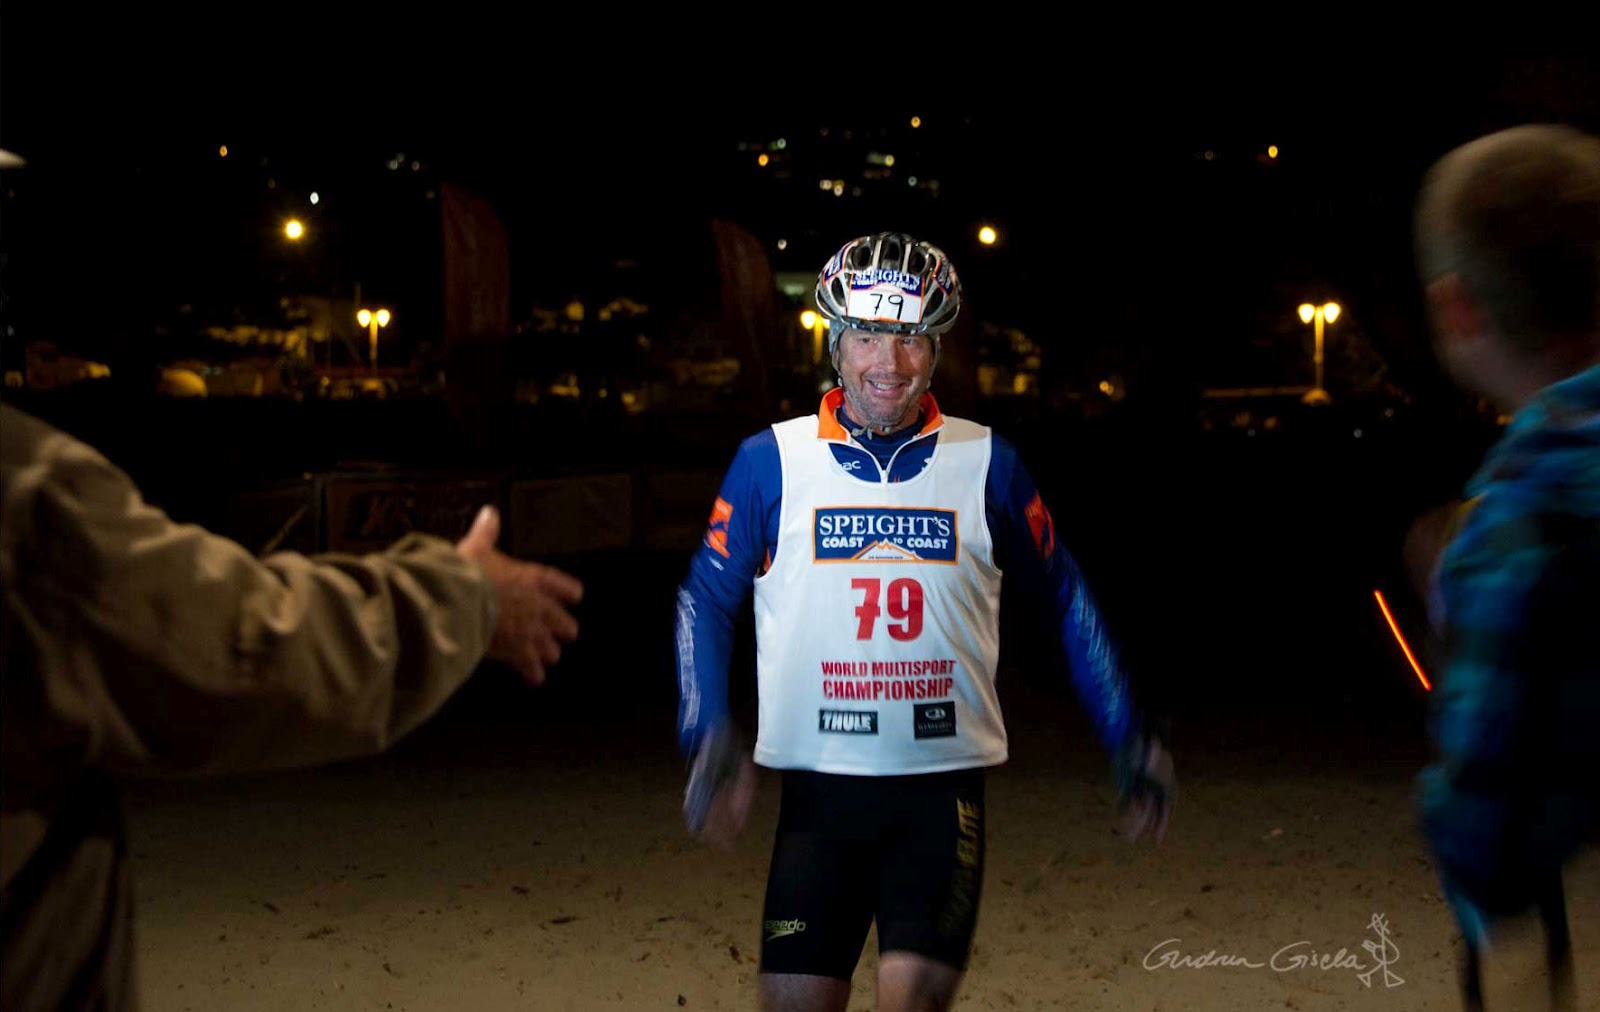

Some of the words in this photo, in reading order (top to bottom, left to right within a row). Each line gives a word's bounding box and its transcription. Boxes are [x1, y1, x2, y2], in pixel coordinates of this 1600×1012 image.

[869, 293, 904, 320] 79
[842, 460, 862, 471] ac
[819, 514, 951, 537] SPEIGHT'S
[822, 536, 864, 549] COAST
[893, 537, 903, 545] TO
[907, 537, 949, 550] COAST
[851, 577, 924, 642] 79
[821, 660, 868, 678] WORLD
[872, 659, 956, 678] MULTISPORT
[822, 677, 954, 701] CHAMPIONSHIP
[822, 711, 872, 732] THULE
